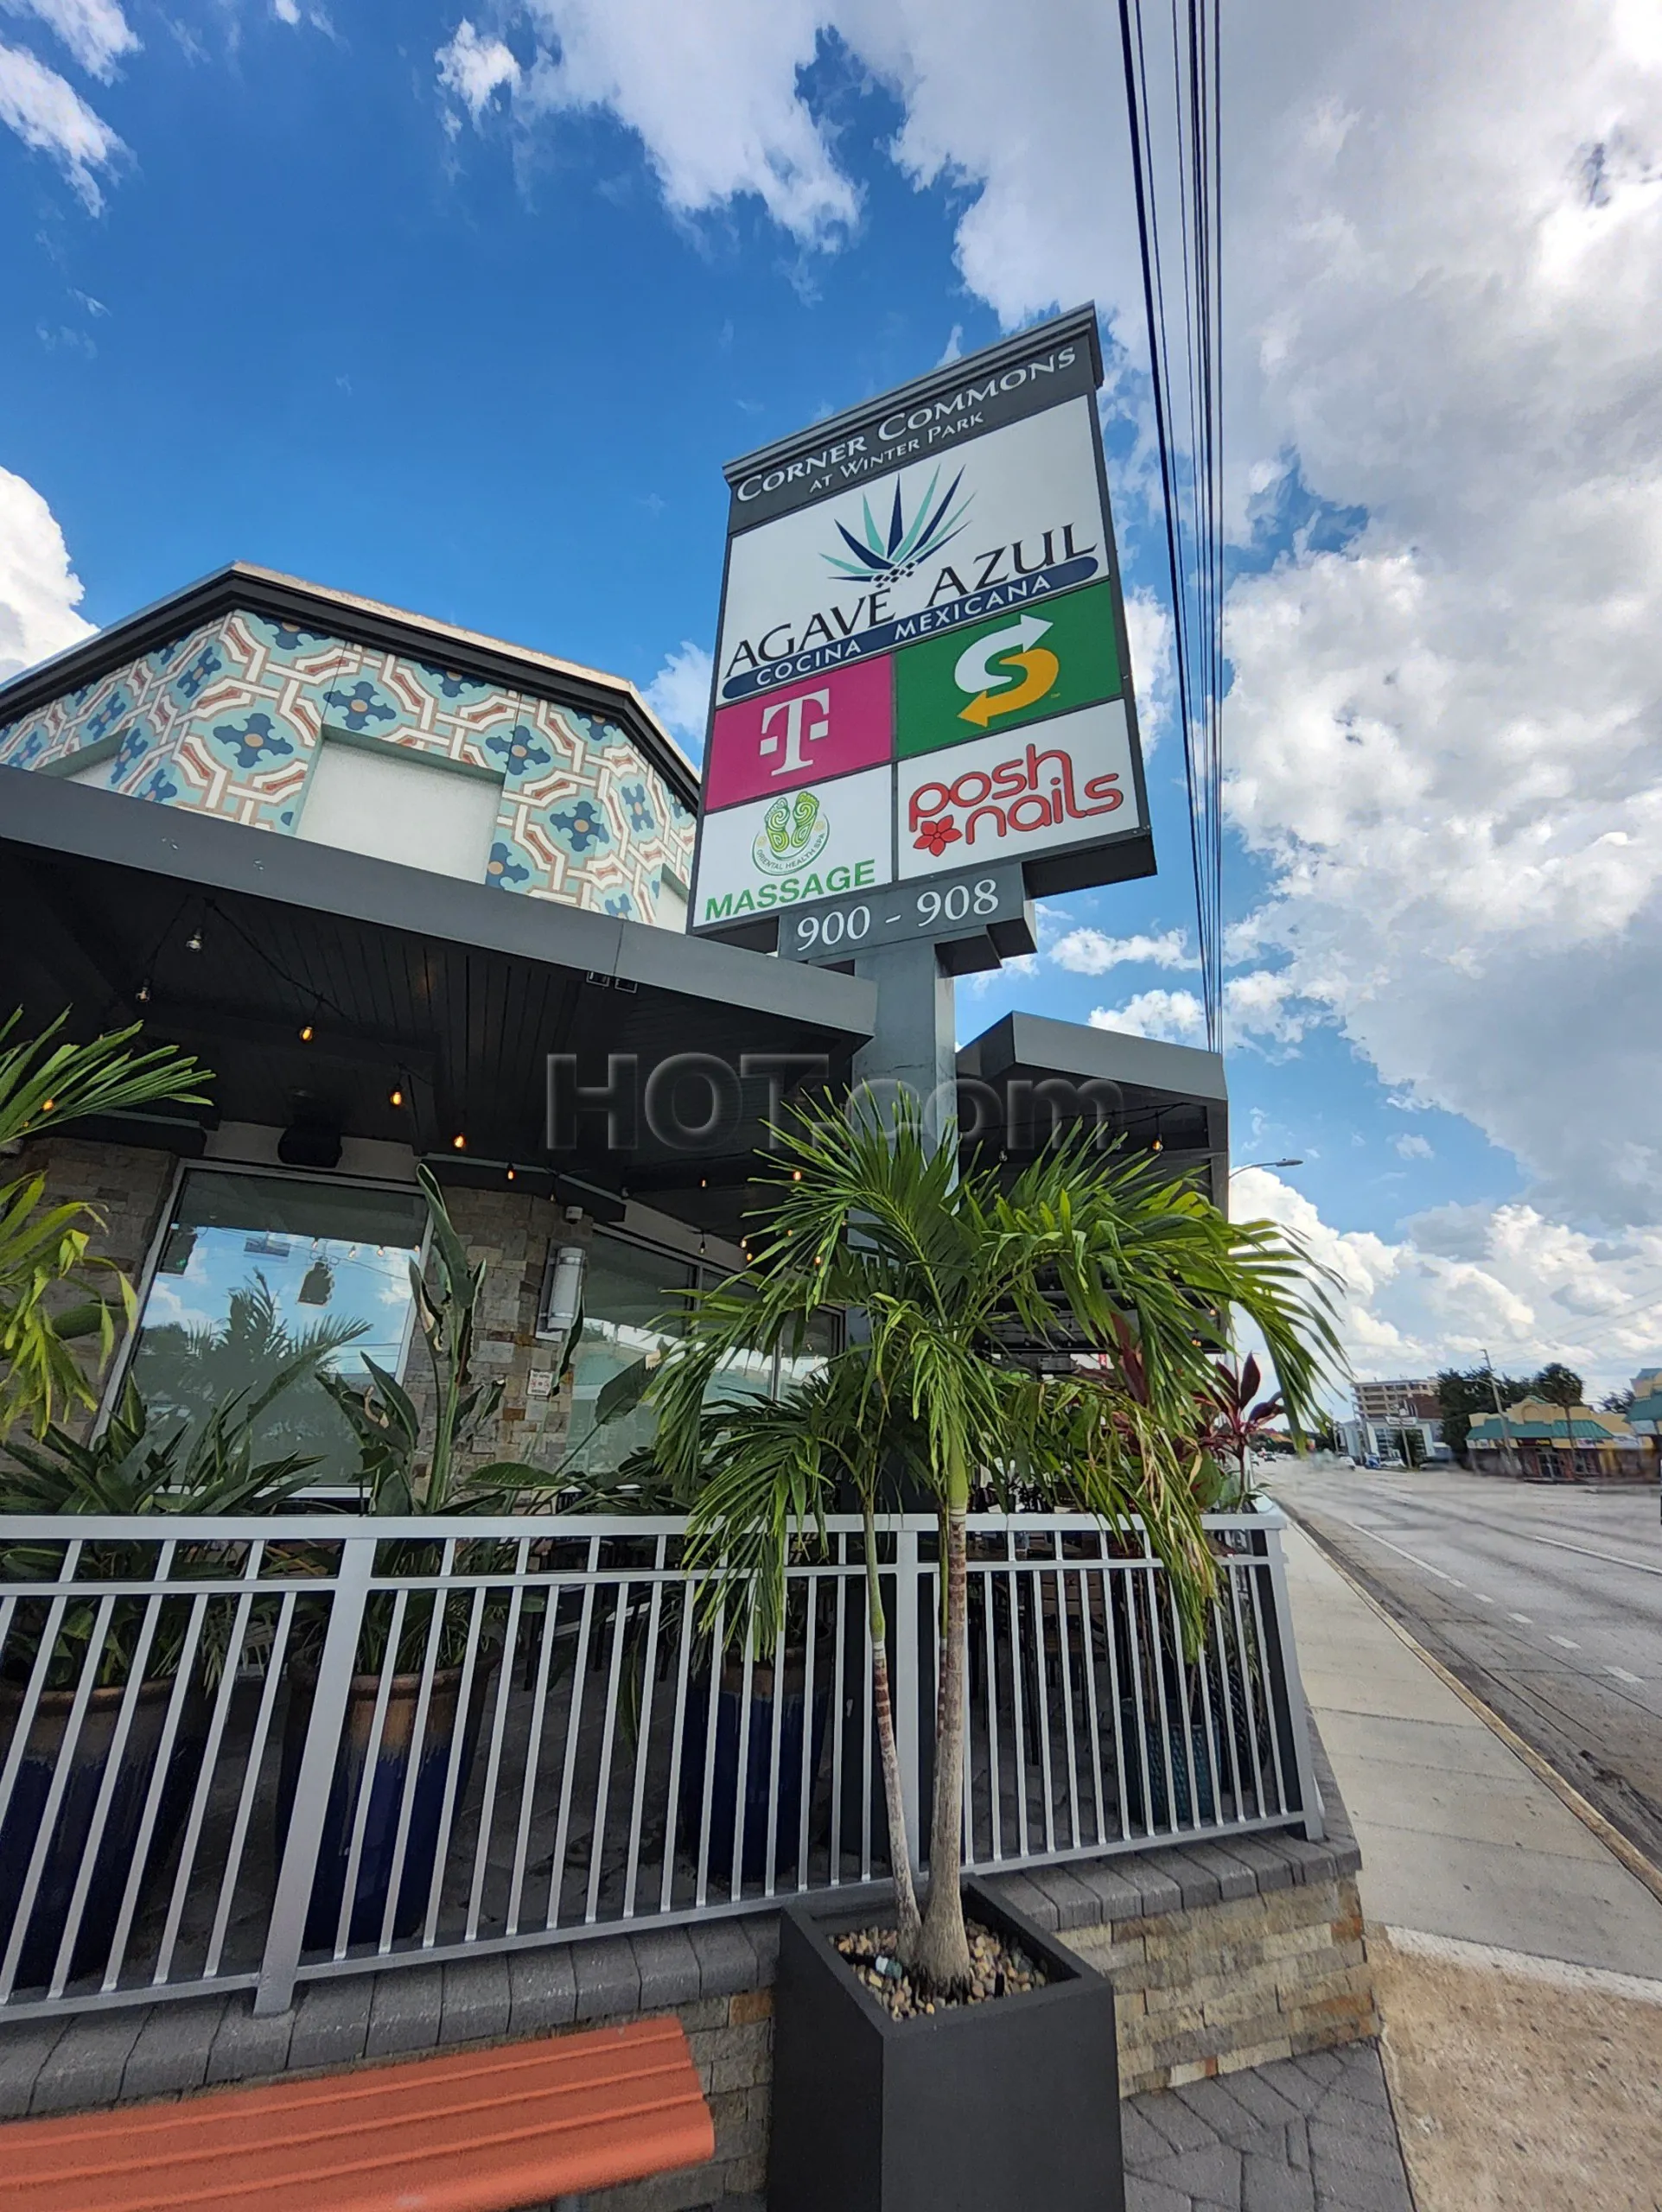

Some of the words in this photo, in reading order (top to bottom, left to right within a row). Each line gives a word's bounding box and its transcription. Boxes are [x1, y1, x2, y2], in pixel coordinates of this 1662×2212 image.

[736, 435, 868, 503] CORNER
[877, 346, 1077, 442] COMMONS
[809, 474, 831, 493] AT
[839, 437, 920, 479] WINTER
[927, 411, 984, 445] PARK
[724, 588, 896, 679] AGAVE
[927, 523, 1098, 607] AZUL
[755, 639, 862, 688] COCINA
[894, 575, 1052, 641] MEXICANA
[760, 688, 830, 777] T
[908, 743, 1073, 833] posh
[965, 773, 1124, 845] nails
[704, 859, 876, 922] MASSAGE
[785, 848, 816, 869] HEALTH
[796, 904, 871, 951] 900
[916, 879, 999, 928] 908
